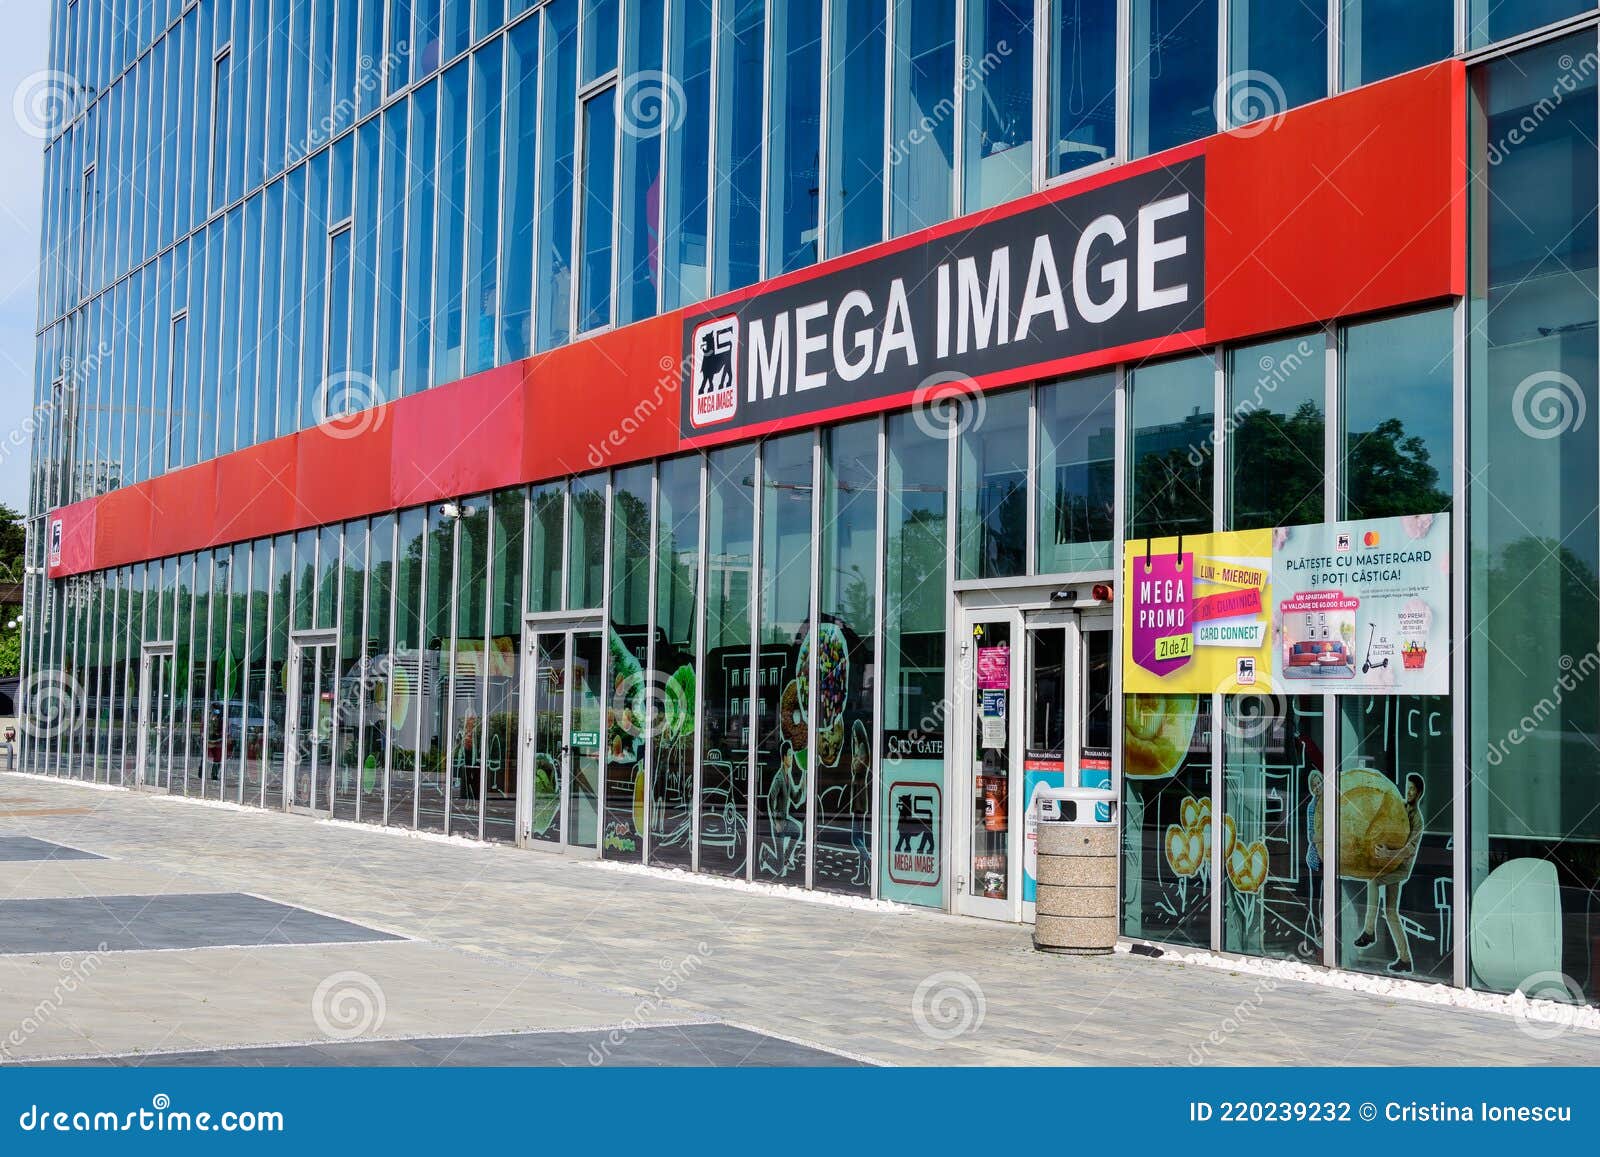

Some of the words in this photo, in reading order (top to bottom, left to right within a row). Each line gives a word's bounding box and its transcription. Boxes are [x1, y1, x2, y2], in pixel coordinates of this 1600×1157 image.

[747, 278, 919, 403] MEGA
[936, 193, 1190, 359] IMAGE
[697, 394, 715, 415] MEGA
[715, 389, 734, 411] IMAGE
[1336, 556, 1352, 567] CU
[1356, 550, 1432, 566] MASTERCARD
[1200, 565, 1215, 579] LUNI
[1222, 568, 1262, 586] MIERCURI
[1140, 579, 1185, 604] MEGA
[1305, 592, 1339, 601] APARTAMENT
[1288, 602, 1311, 610] VALOARE
[1339, 600, 1357, 608] EURO
[1139, 608, 1185, 629] PROMO
[1200, 626, 1219, 641] CARD
[1221, 626, 1259, 640] CONNECT
[1160, 640, 1169, 656] ZI
[1169, 638, 1179, 655] de
[1180, 636, 1189, 653] ZI
[917, 740, 943, 754] GATE
[894, 852, 913, 873] MEGA
[914, 853, 935, 874] IMAGE
